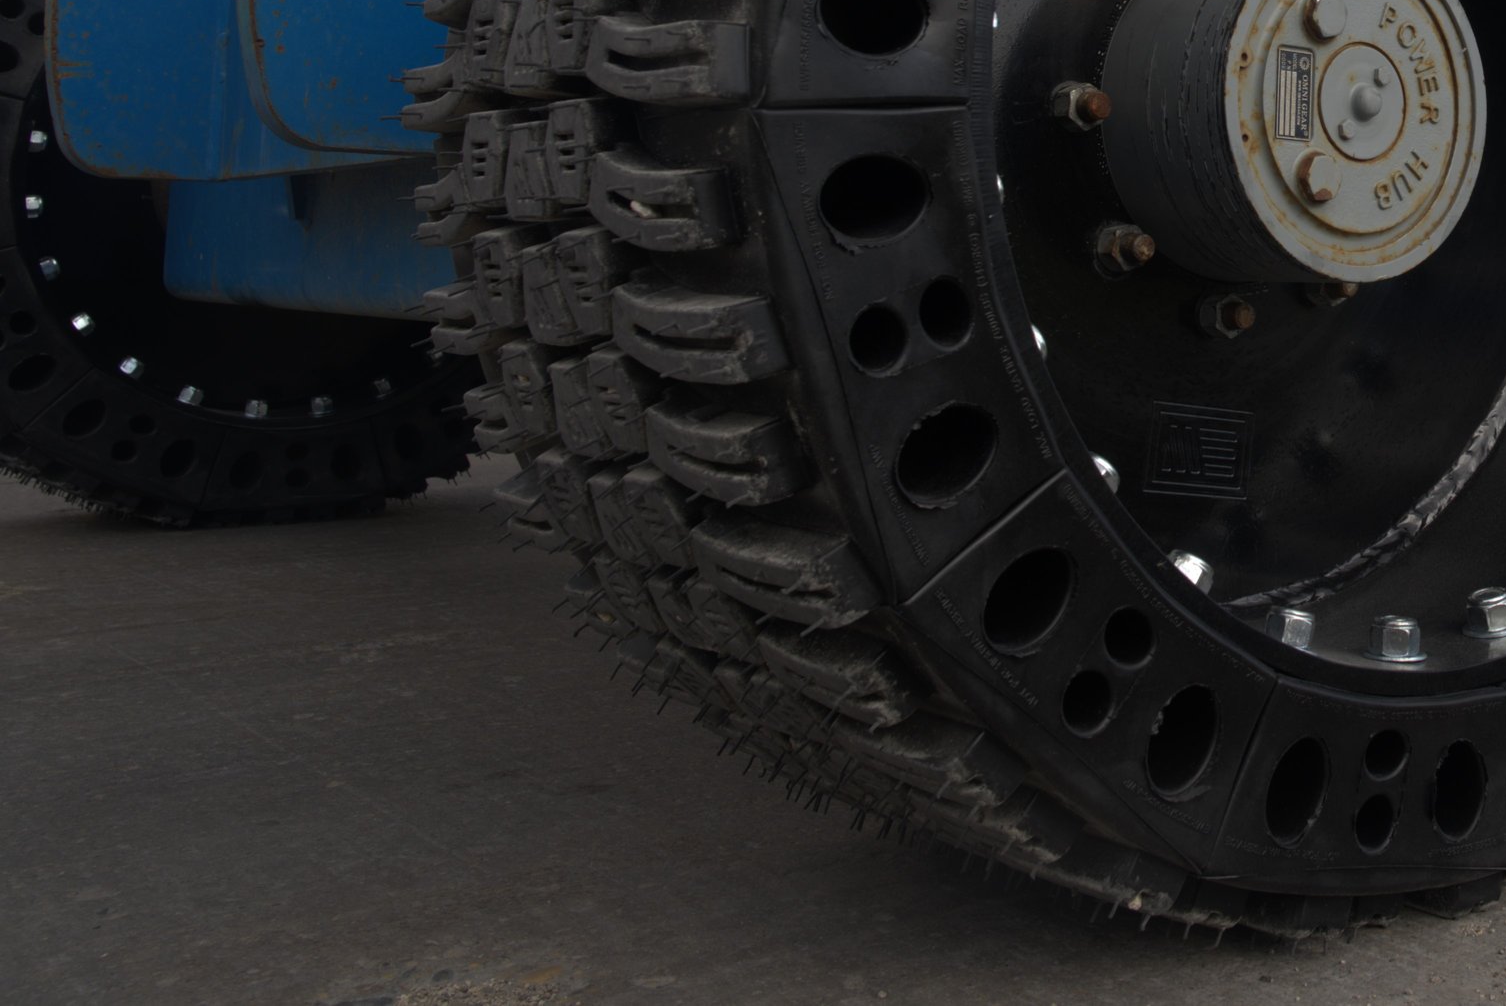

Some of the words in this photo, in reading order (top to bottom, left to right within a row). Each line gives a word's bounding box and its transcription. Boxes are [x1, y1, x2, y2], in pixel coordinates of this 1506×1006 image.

[956, 18, 968, 51] LOAD
[1378, 2, 1440, 126] POWER
[1374, 147, 1429, 210] HUB
